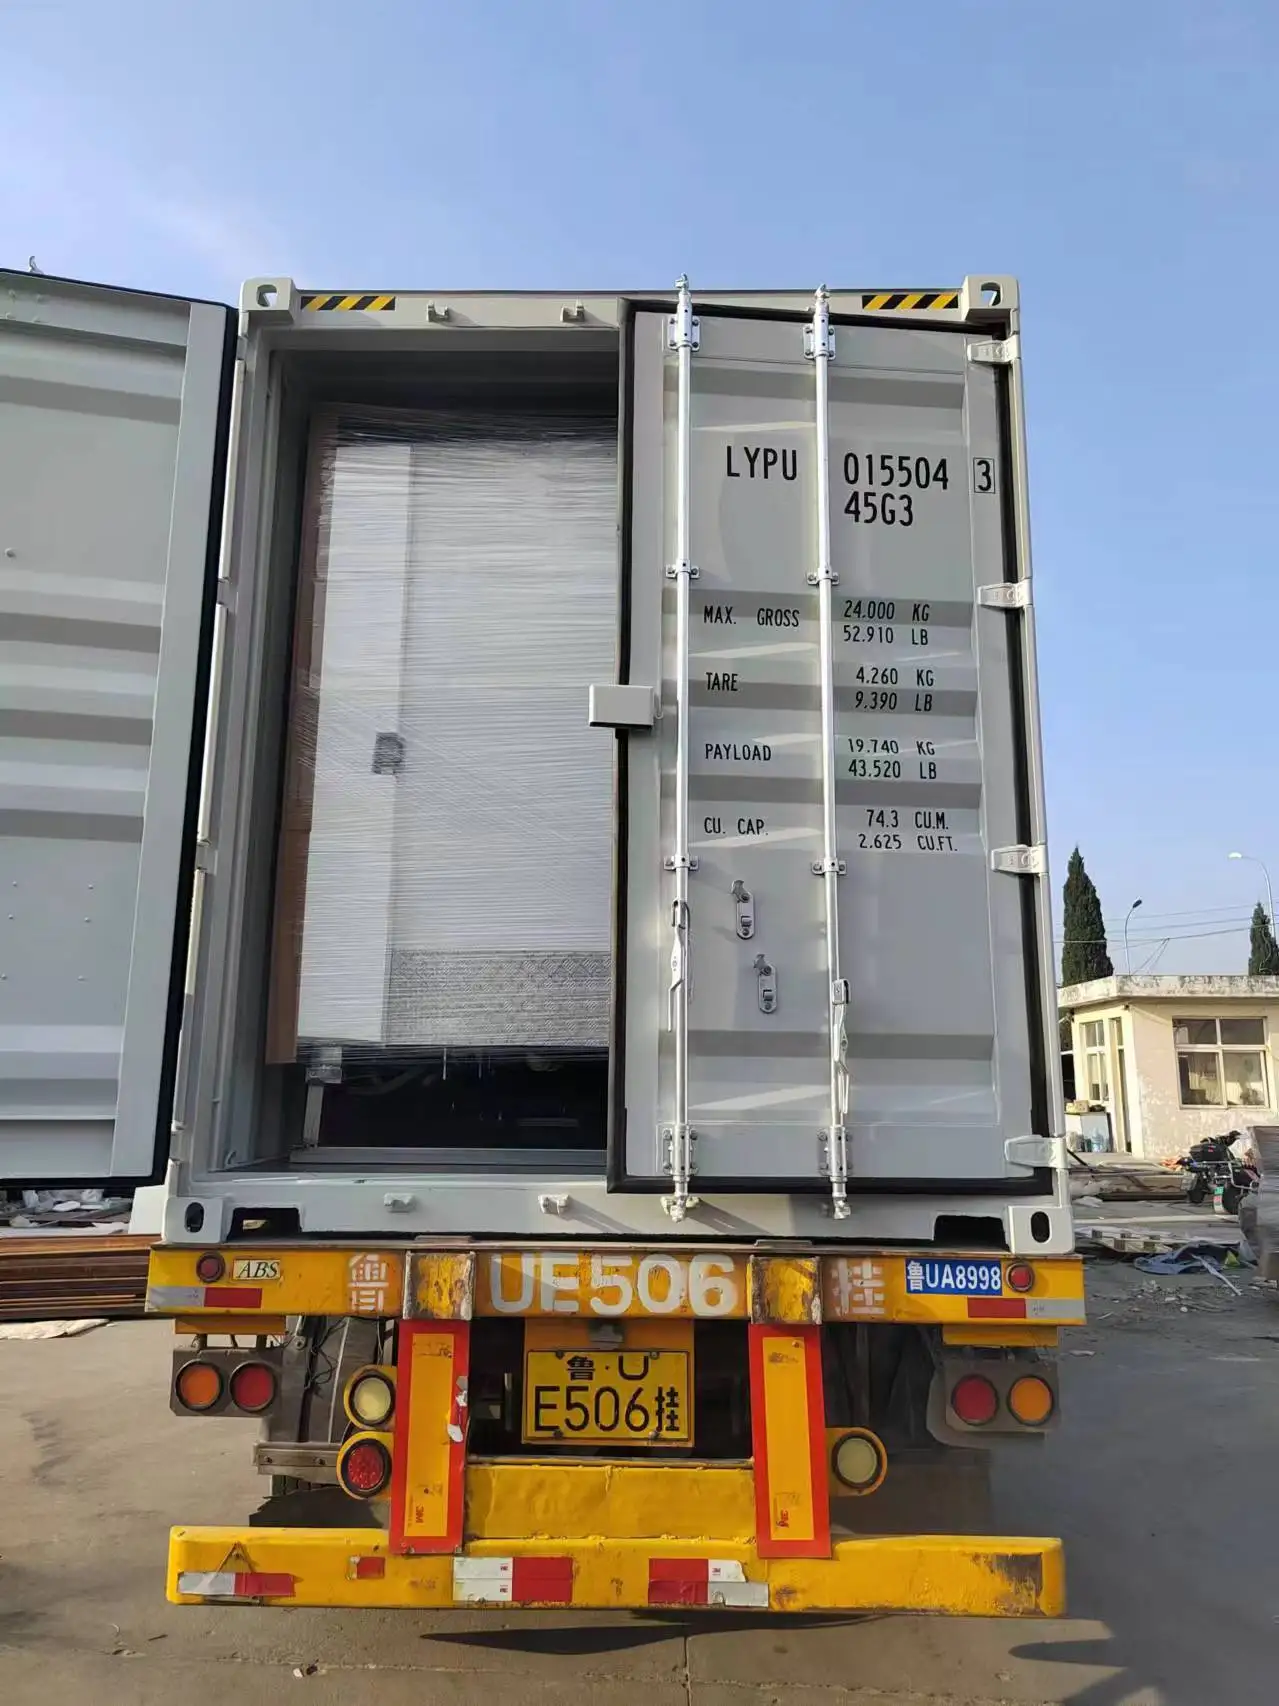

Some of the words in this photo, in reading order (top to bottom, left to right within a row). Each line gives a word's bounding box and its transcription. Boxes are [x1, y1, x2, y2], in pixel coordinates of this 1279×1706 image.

[726, 445, 797, 481] LYPU
[843, 452, 949, 490] 015504
[976, 459, 992, 492] 3
[844, 491, 914, 527] 45G3
[703, 605, 737, 626] MAX.
[757, 608, 800, 628] GROSS
[844, 600, 895, 621] 24.000
[912, 604, 930, 622] KG
[843, 625, 894, 644] 52.910
[912, 628, 929, 646] LB
[705, 672, 739, 692] TARE
[856, 667, 899, 686] 4.260
[916, 669, 934, 687] KG
[855, 692, 898, 711] 9.390
[915, 694, 933, 712] LB
[705, 743, 772, 762] PAYLOAD
[848, 738, 899, 755] 19.740
[916, 740, 935, 756] KG
[848, 759, 901, 779] 43.520
[919, 762, 937, 780] LB
[704, 817, 727, 835] CU.
[737, 818, 769, 837] CAP.
[866, 809, 899, 829] 74.3
[914, 811, 949, 831] CU.M.
[858, 833, 902, 850] 2.625
[917, 835, 958, 853] CU.FT.
[237, 1261, 280, 1278] ABS
[907, 1260, 1001, 1292] 鲁UA8998
[490, 1253, 737, 1316] UE506
